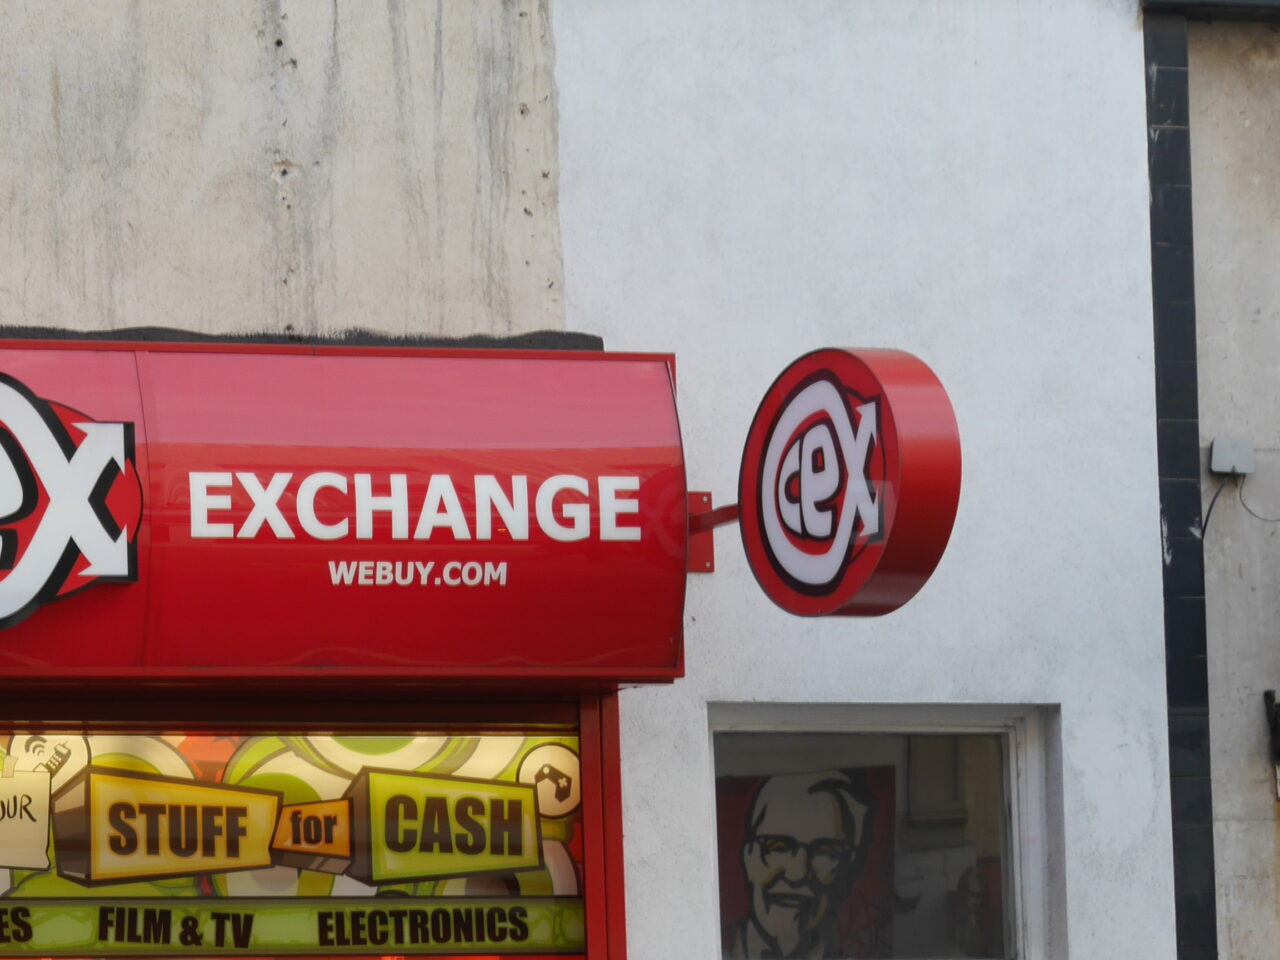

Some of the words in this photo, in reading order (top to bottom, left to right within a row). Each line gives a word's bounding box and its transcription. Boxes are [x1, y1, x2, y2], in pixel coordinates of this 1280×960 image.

[187, 471, 643, 542] EXCHANGE
[327, 559, 509, 588] WEBUY.COM
[107, 801, 249, 859] STUFF
[289, 809, 338, 846] for
[383, 794, 526, 857] CASH
[98, 905, 172, 946] FILM
[180, 915, 204, 947] &
[210, 912, 255, 949] TV
[319, 906, 530, 947] ELECTRONICS
